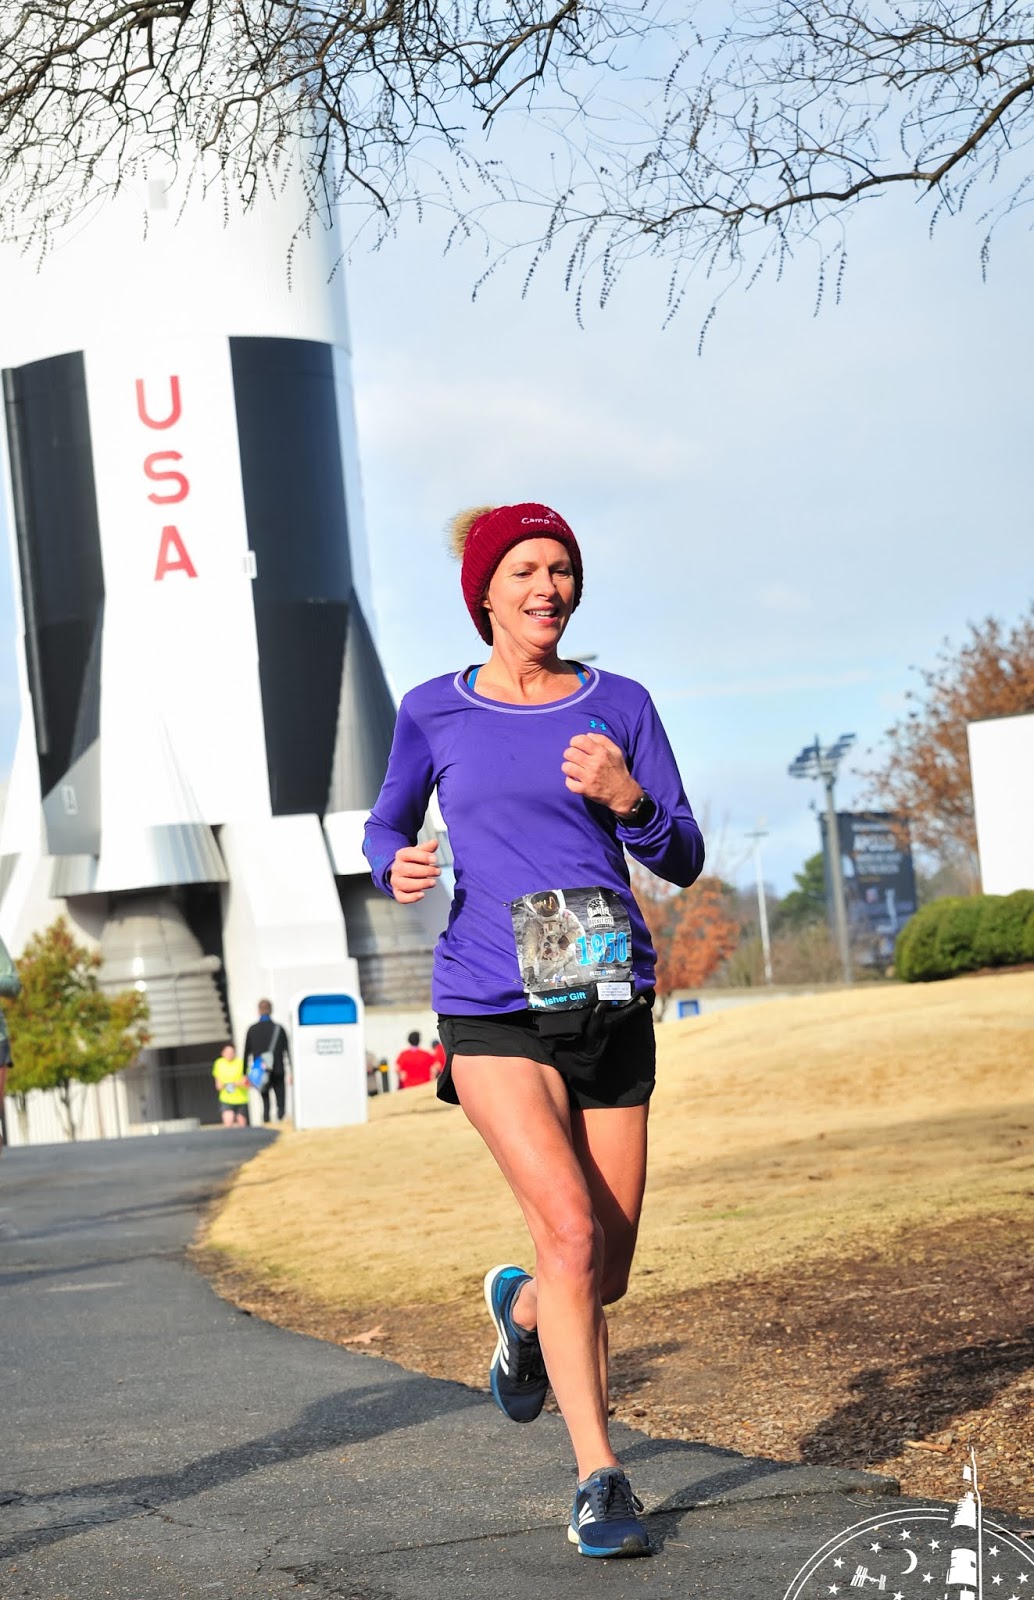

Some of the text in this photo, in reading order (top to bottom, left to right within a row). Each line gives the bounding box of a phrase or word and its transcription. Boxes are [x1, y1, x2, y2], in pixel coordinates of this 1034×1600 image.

[135, 375, 198, 581] USA
[577, 932, 628, 966] 1950
[531, 992, 586, 1008] Fisher Gift
